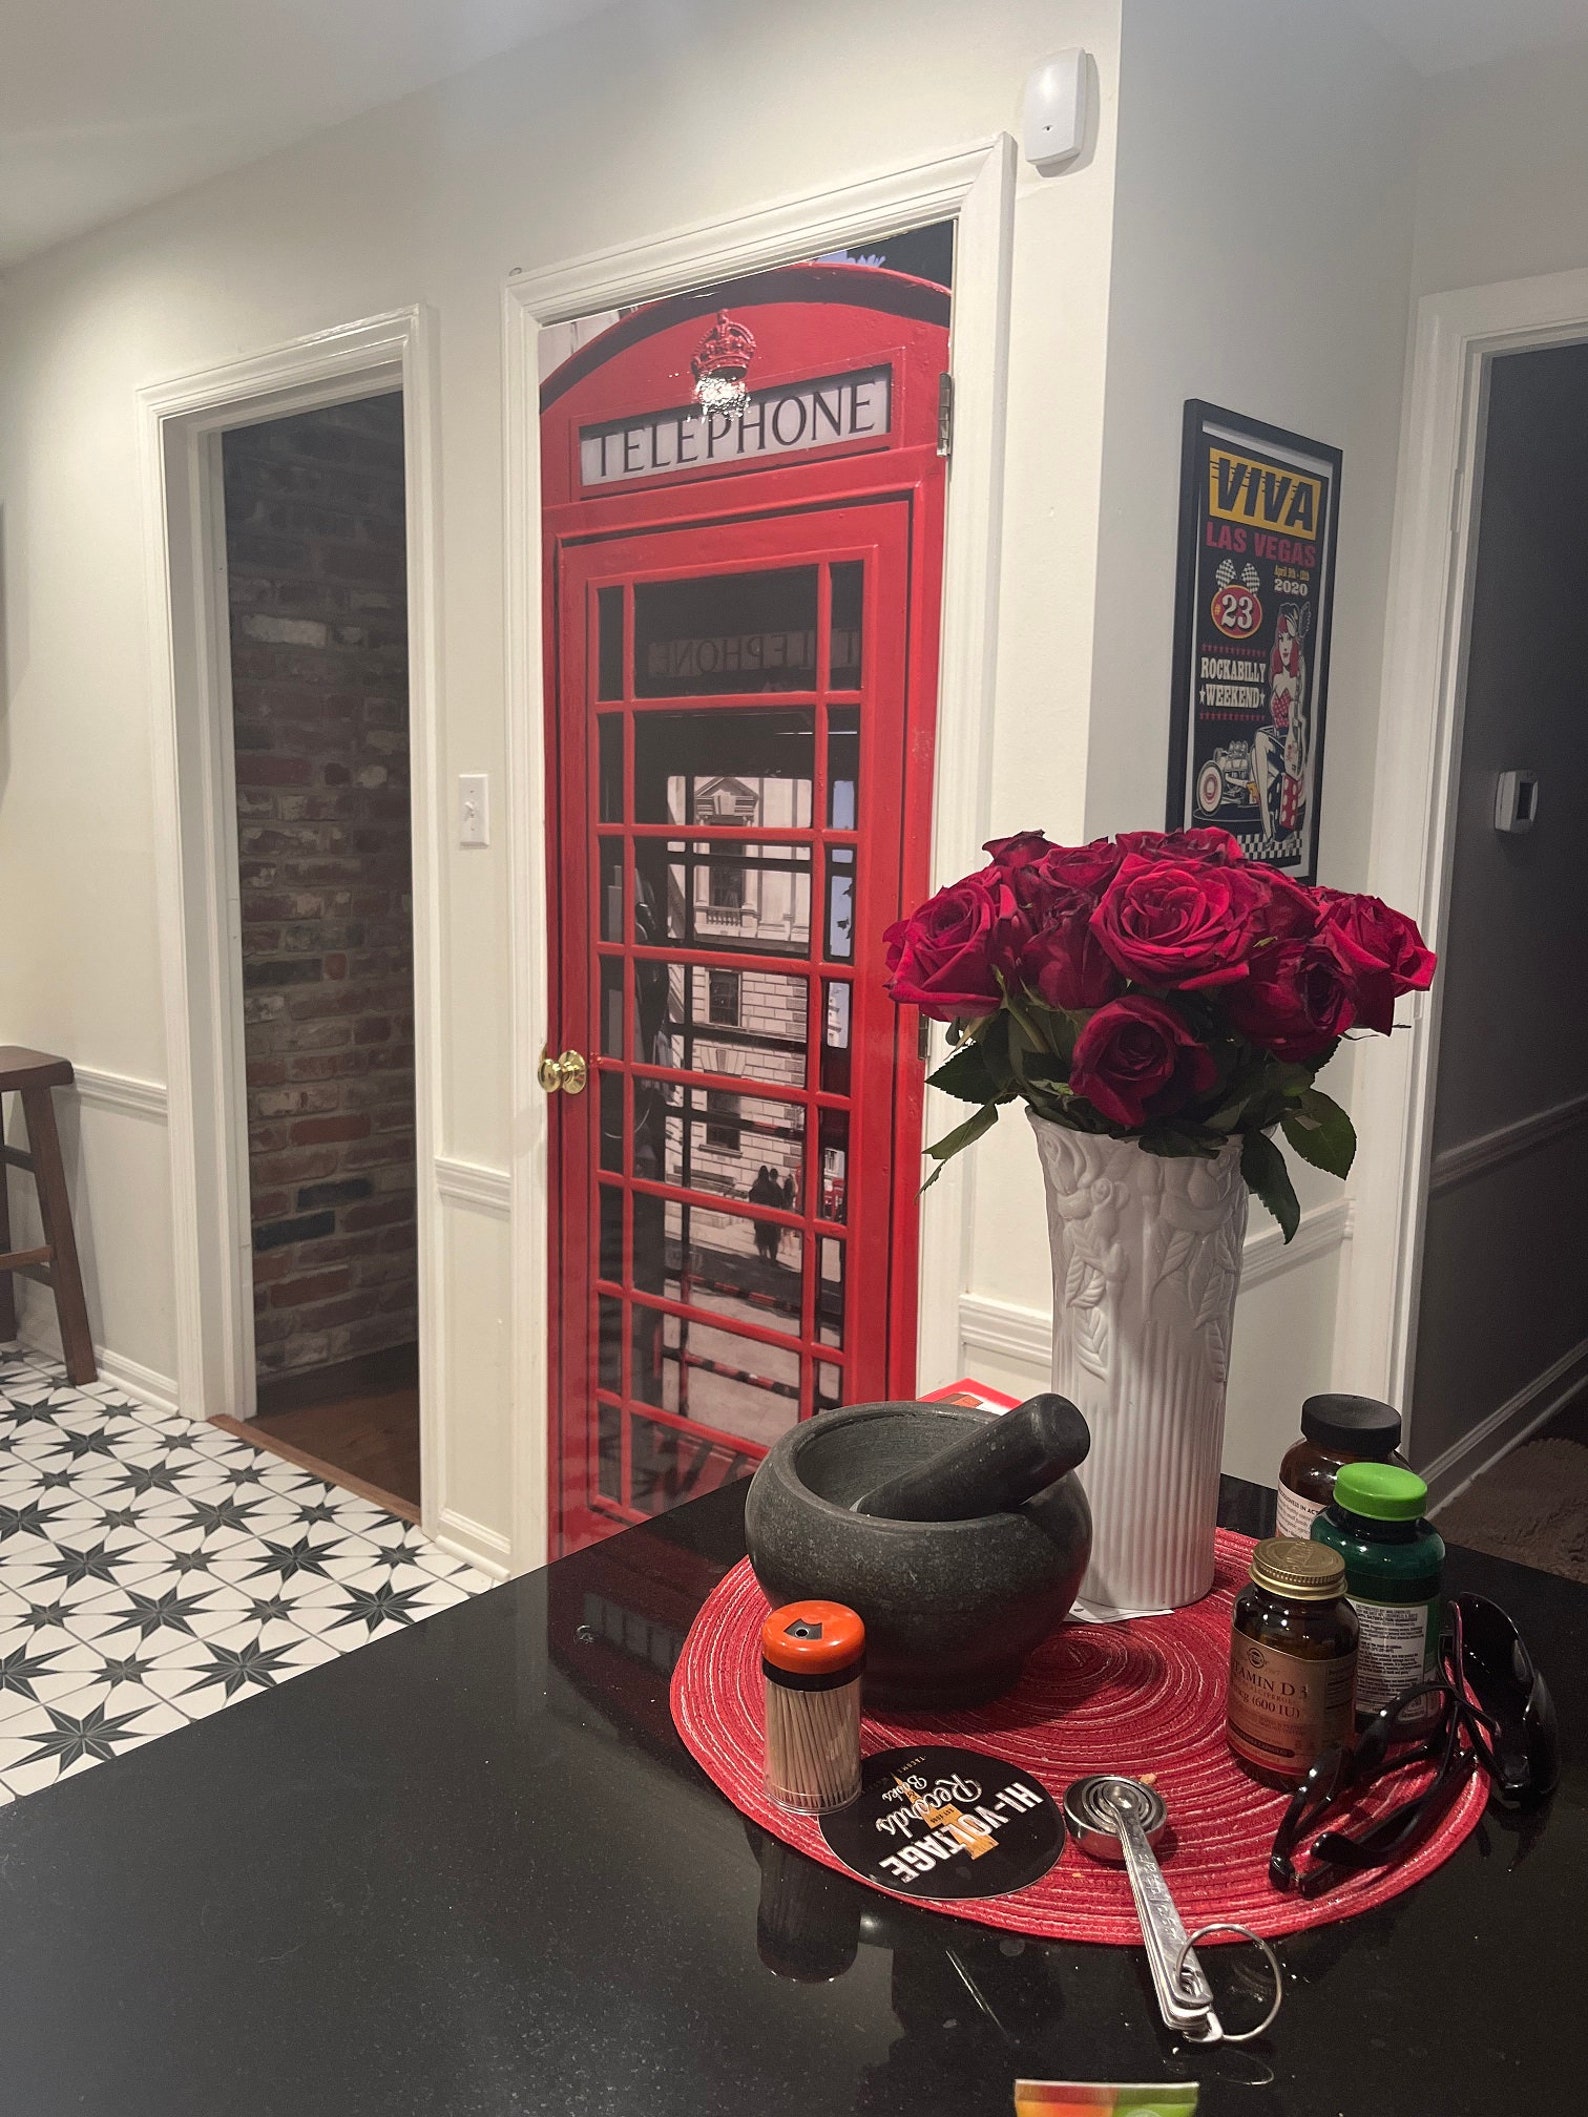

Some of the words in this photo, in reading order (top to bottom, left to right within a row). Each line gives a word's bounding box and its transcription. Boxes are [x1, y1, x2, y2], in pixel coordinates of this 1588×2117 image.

[595, 380, 877, 477] TELEPHONE
[1218, 456, 1314, 531] VIVA
[1206, 521, 1247, 553] LAS
[1254, 532, 1317, 567] VEGAS
[1274, 578, 1308, 596] 2020
[1221, 594, 1253, 630] 23
[1201, 656, 1267, 683] ROCKABILLY
[1206, 684, 1260, 708] WEEKEND
[875, 1773, 982, 1839] Records
[882, 1774, 927, 1802] Books
[878, 1782, 1044, 1883] HI-VOLTAGE
